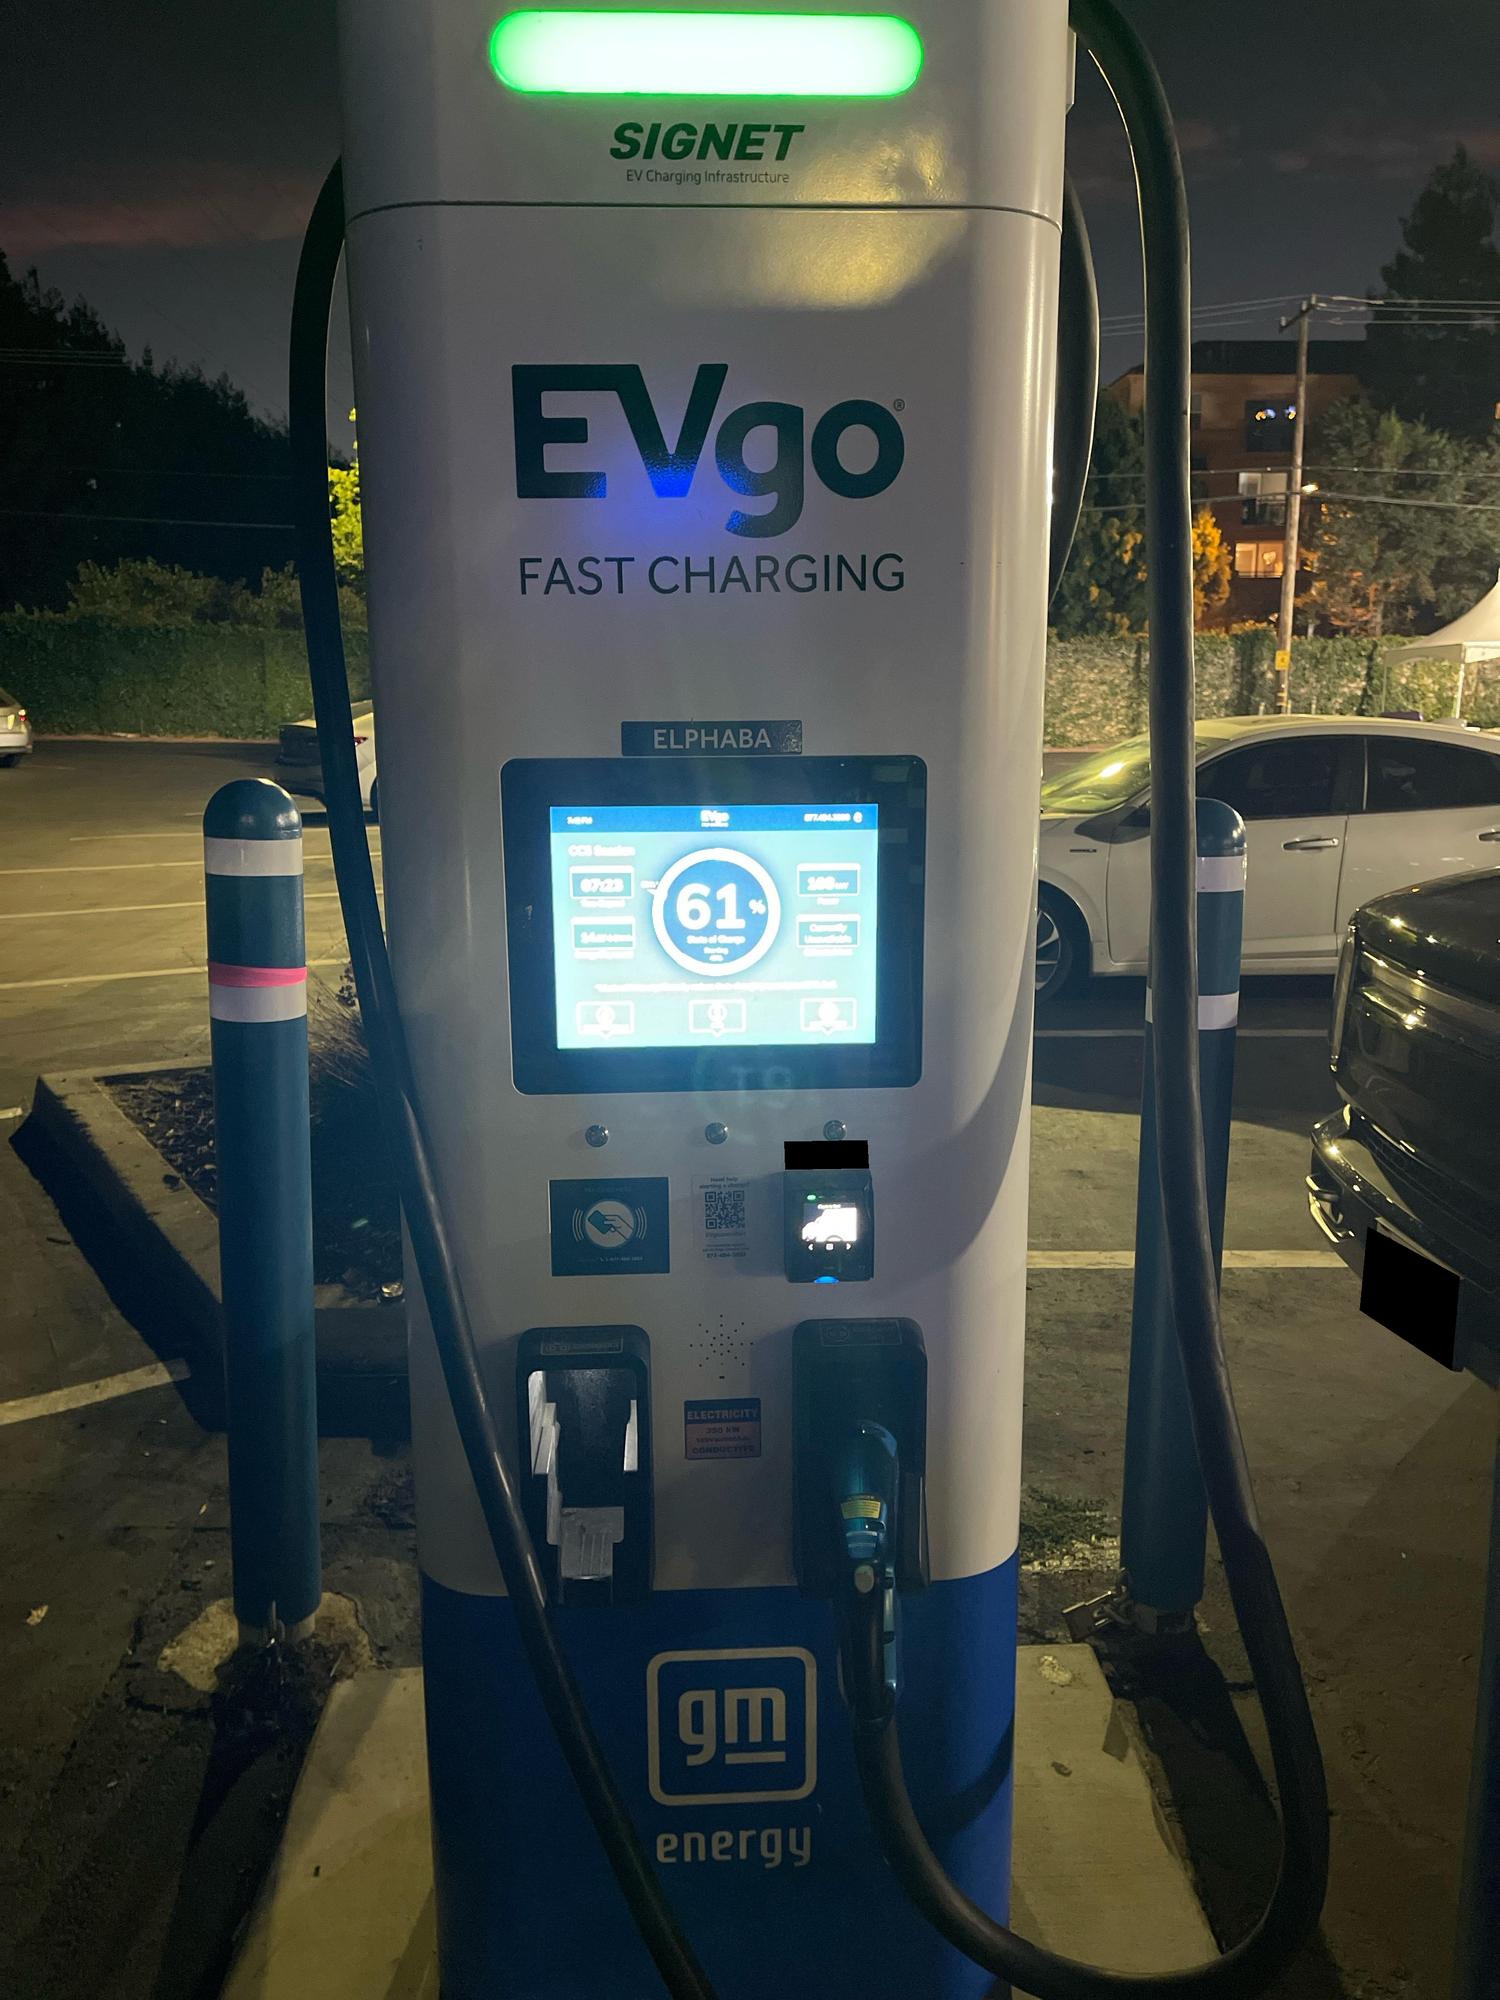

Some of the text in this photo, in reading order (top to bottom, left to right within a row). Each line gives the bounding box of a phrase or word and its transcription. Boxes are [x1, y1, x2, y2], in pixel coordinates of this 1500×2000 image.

[609, 122, 806, 161] SIGNET
[626, 169, 790, 185] EV Charging Infrastructure
[511, 363, 905, 538] EVgo
[519, 553, 905, 595] FAST CHARGING
[653, 728, 772, 749] ELPHABA
[687, 1408, 759, 1420] ELECTRICITY
[678, 1687, 787, 1767] gm
[656, 1826, 812, 1869] energy
